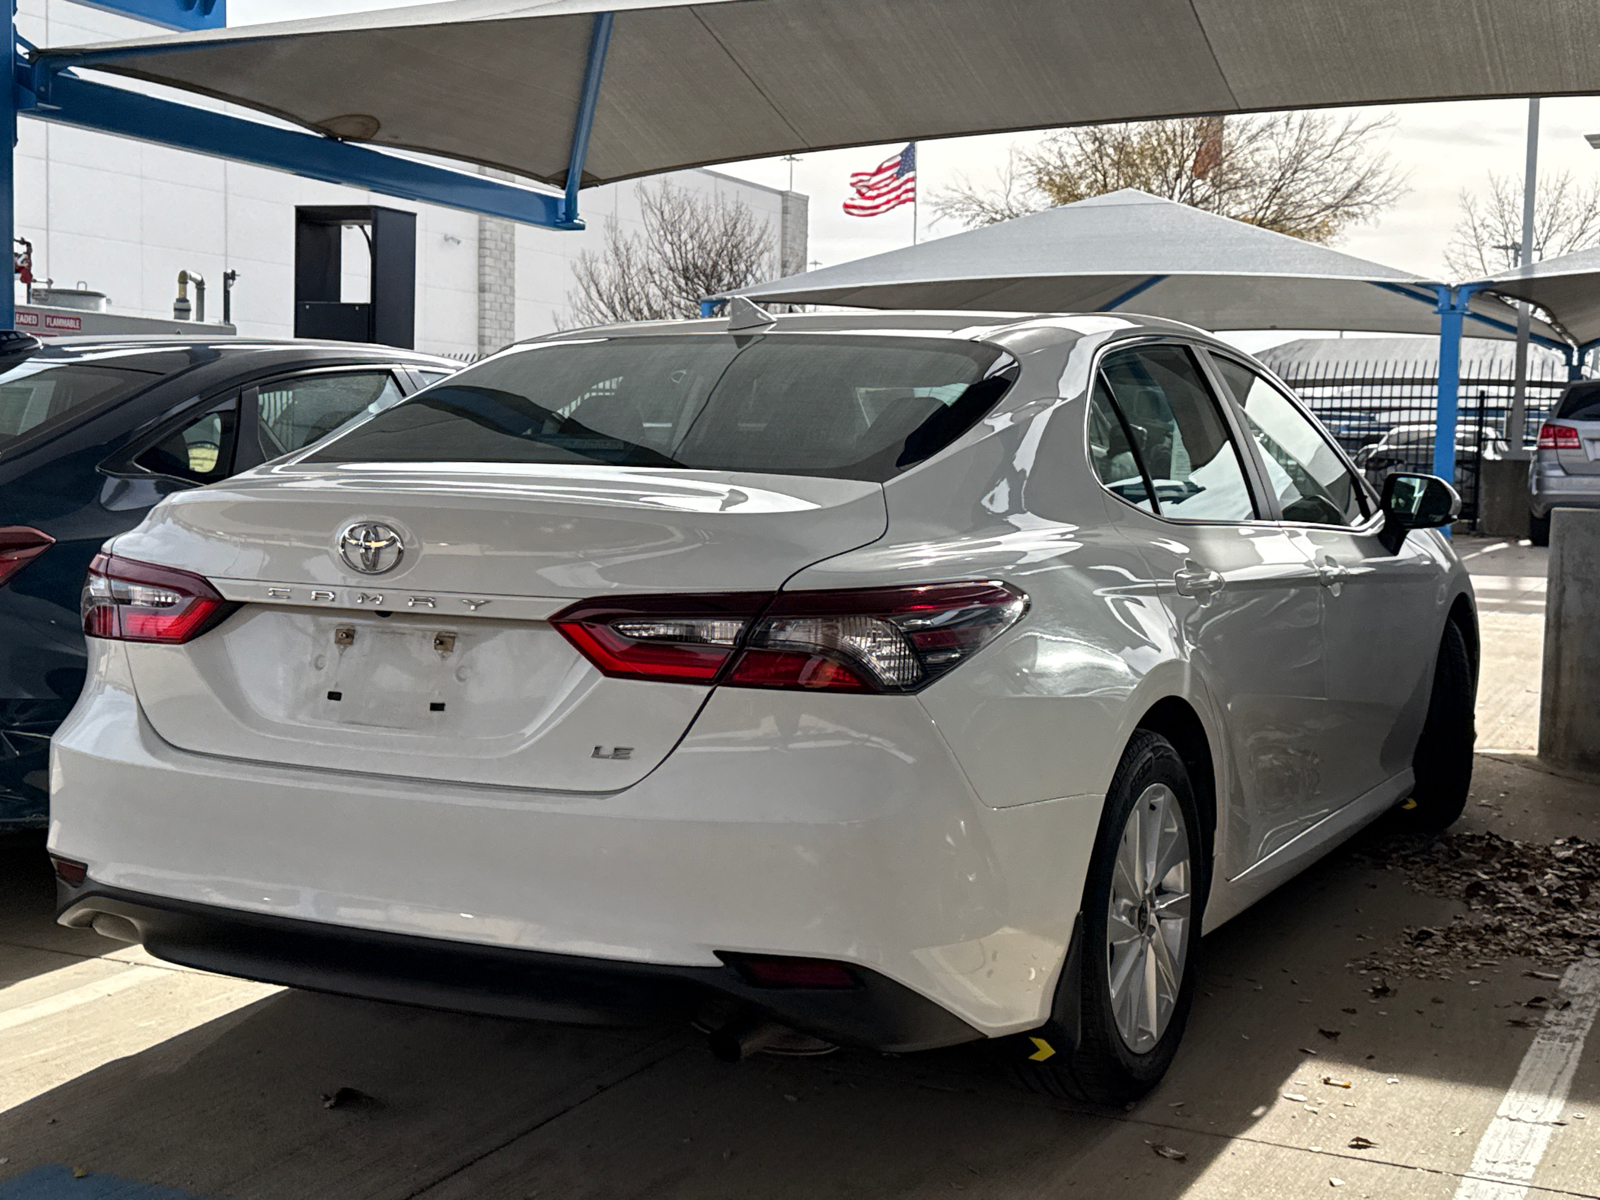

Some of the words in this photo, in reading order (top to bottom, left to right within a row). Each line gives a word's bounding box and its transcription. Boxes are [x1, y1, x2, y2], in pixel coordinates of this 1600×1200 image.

[15, 313, 37, 325] EADED
[46, 316, 80, 329] FLAMMABLE
[268, 587, 491, 611] CAMRY
[590, 745, 634, 760] LE
